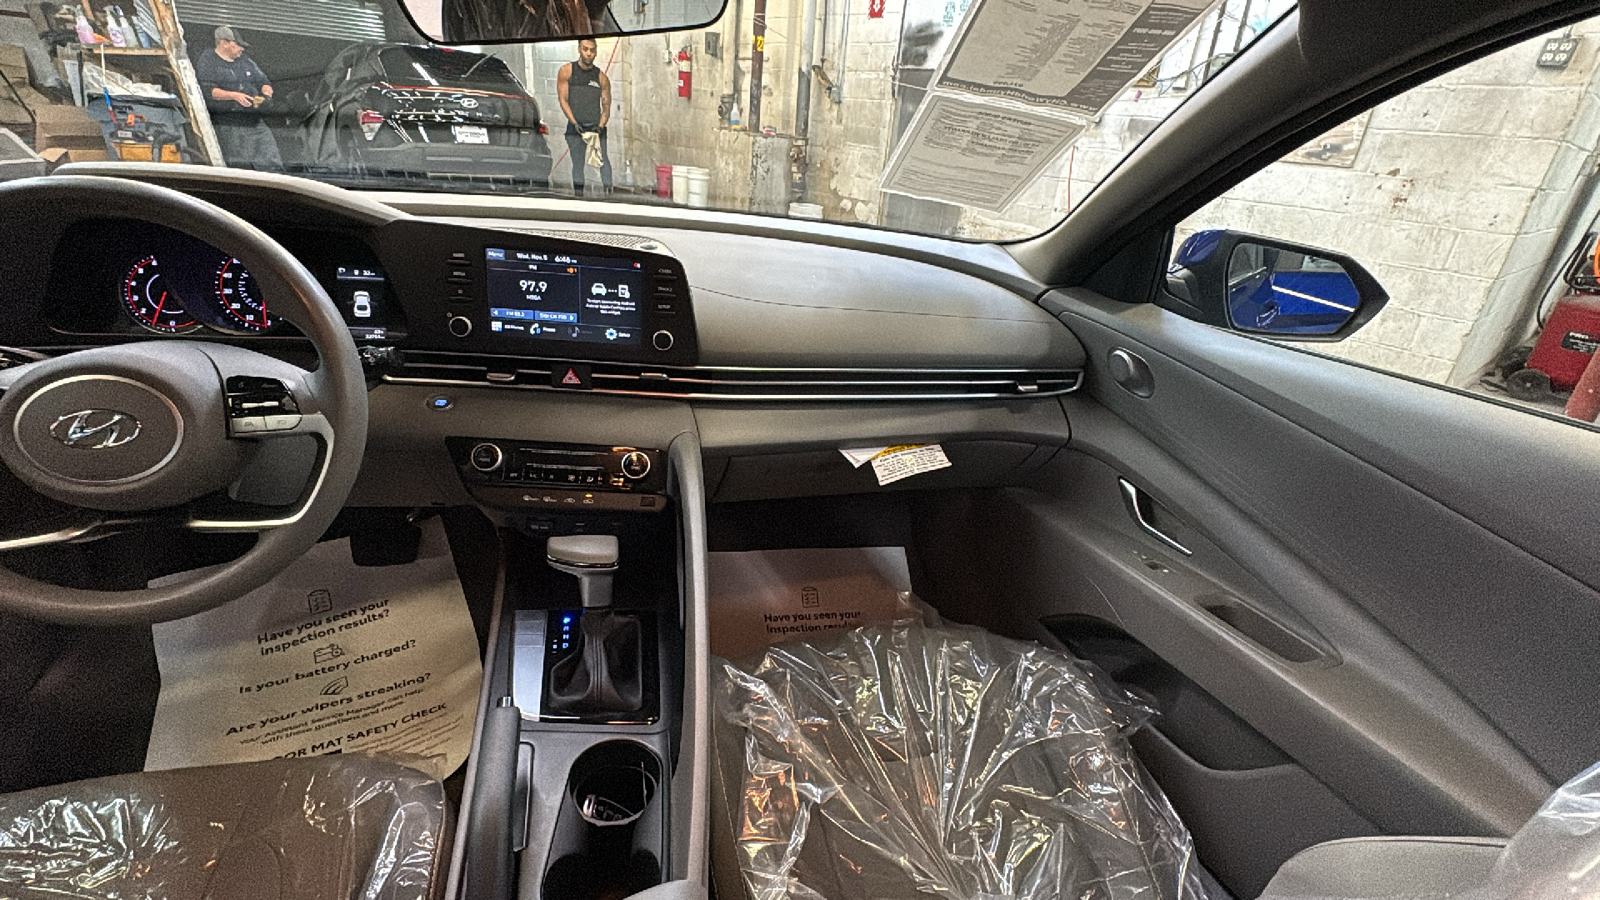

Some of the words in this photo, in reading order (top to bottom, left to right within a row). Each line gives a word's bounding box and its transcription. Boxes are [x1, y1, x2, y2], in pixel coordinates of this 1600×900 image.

[519, 280, 548, 292] 97.9
[257, 628, 293, 644] Have
[296, 620, 322, 635] you
[325, 608, 357, 624] seen
[359, 599, 389, 615] your
[260, 627, 336, 656] inspection
[338, 609, 390, 632] results?
[764, 614, 790, 622] Have
[792, 613, 811, 622] you
[813, 612, 837, 620] seen
[839, 611, 860, 619] your
[239, 685, 252, 694] Is
[255, 677, 291, 692] your
[295, 661, 350, 681] battery
[353, 639, 417, 665] charged?
[226, 723, 256, 736] Are
[260, 711, 297, 728] your
[301, 696, 353, 714] wipers
[357, 672, 431, 700] streaking?
[311, 736, 343, 753] MAT
[347, 719, 399, 742] SAFETY
[401, 702, 447, 724] CHECK
